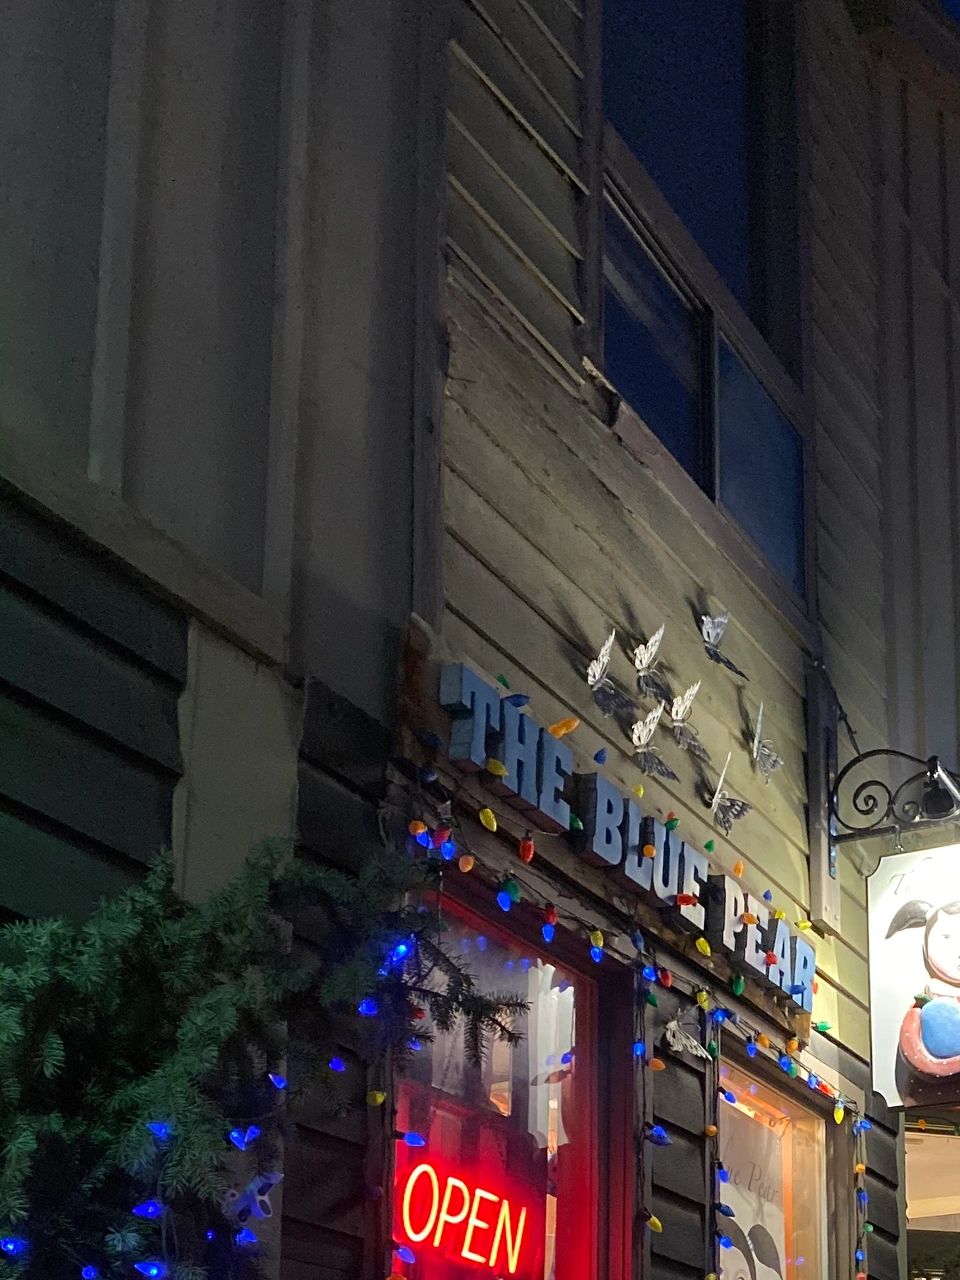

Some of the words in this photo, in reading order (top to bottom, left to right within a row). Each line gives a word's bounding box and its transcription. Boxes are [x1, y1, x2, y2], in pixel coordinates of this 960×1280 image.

[456, 663, 574, 831] THE
[592, 772, 709, 931] BLUE
[722, 874, 817, 1014] PEAR
[400, 1162, 527, 1275] OPEN
